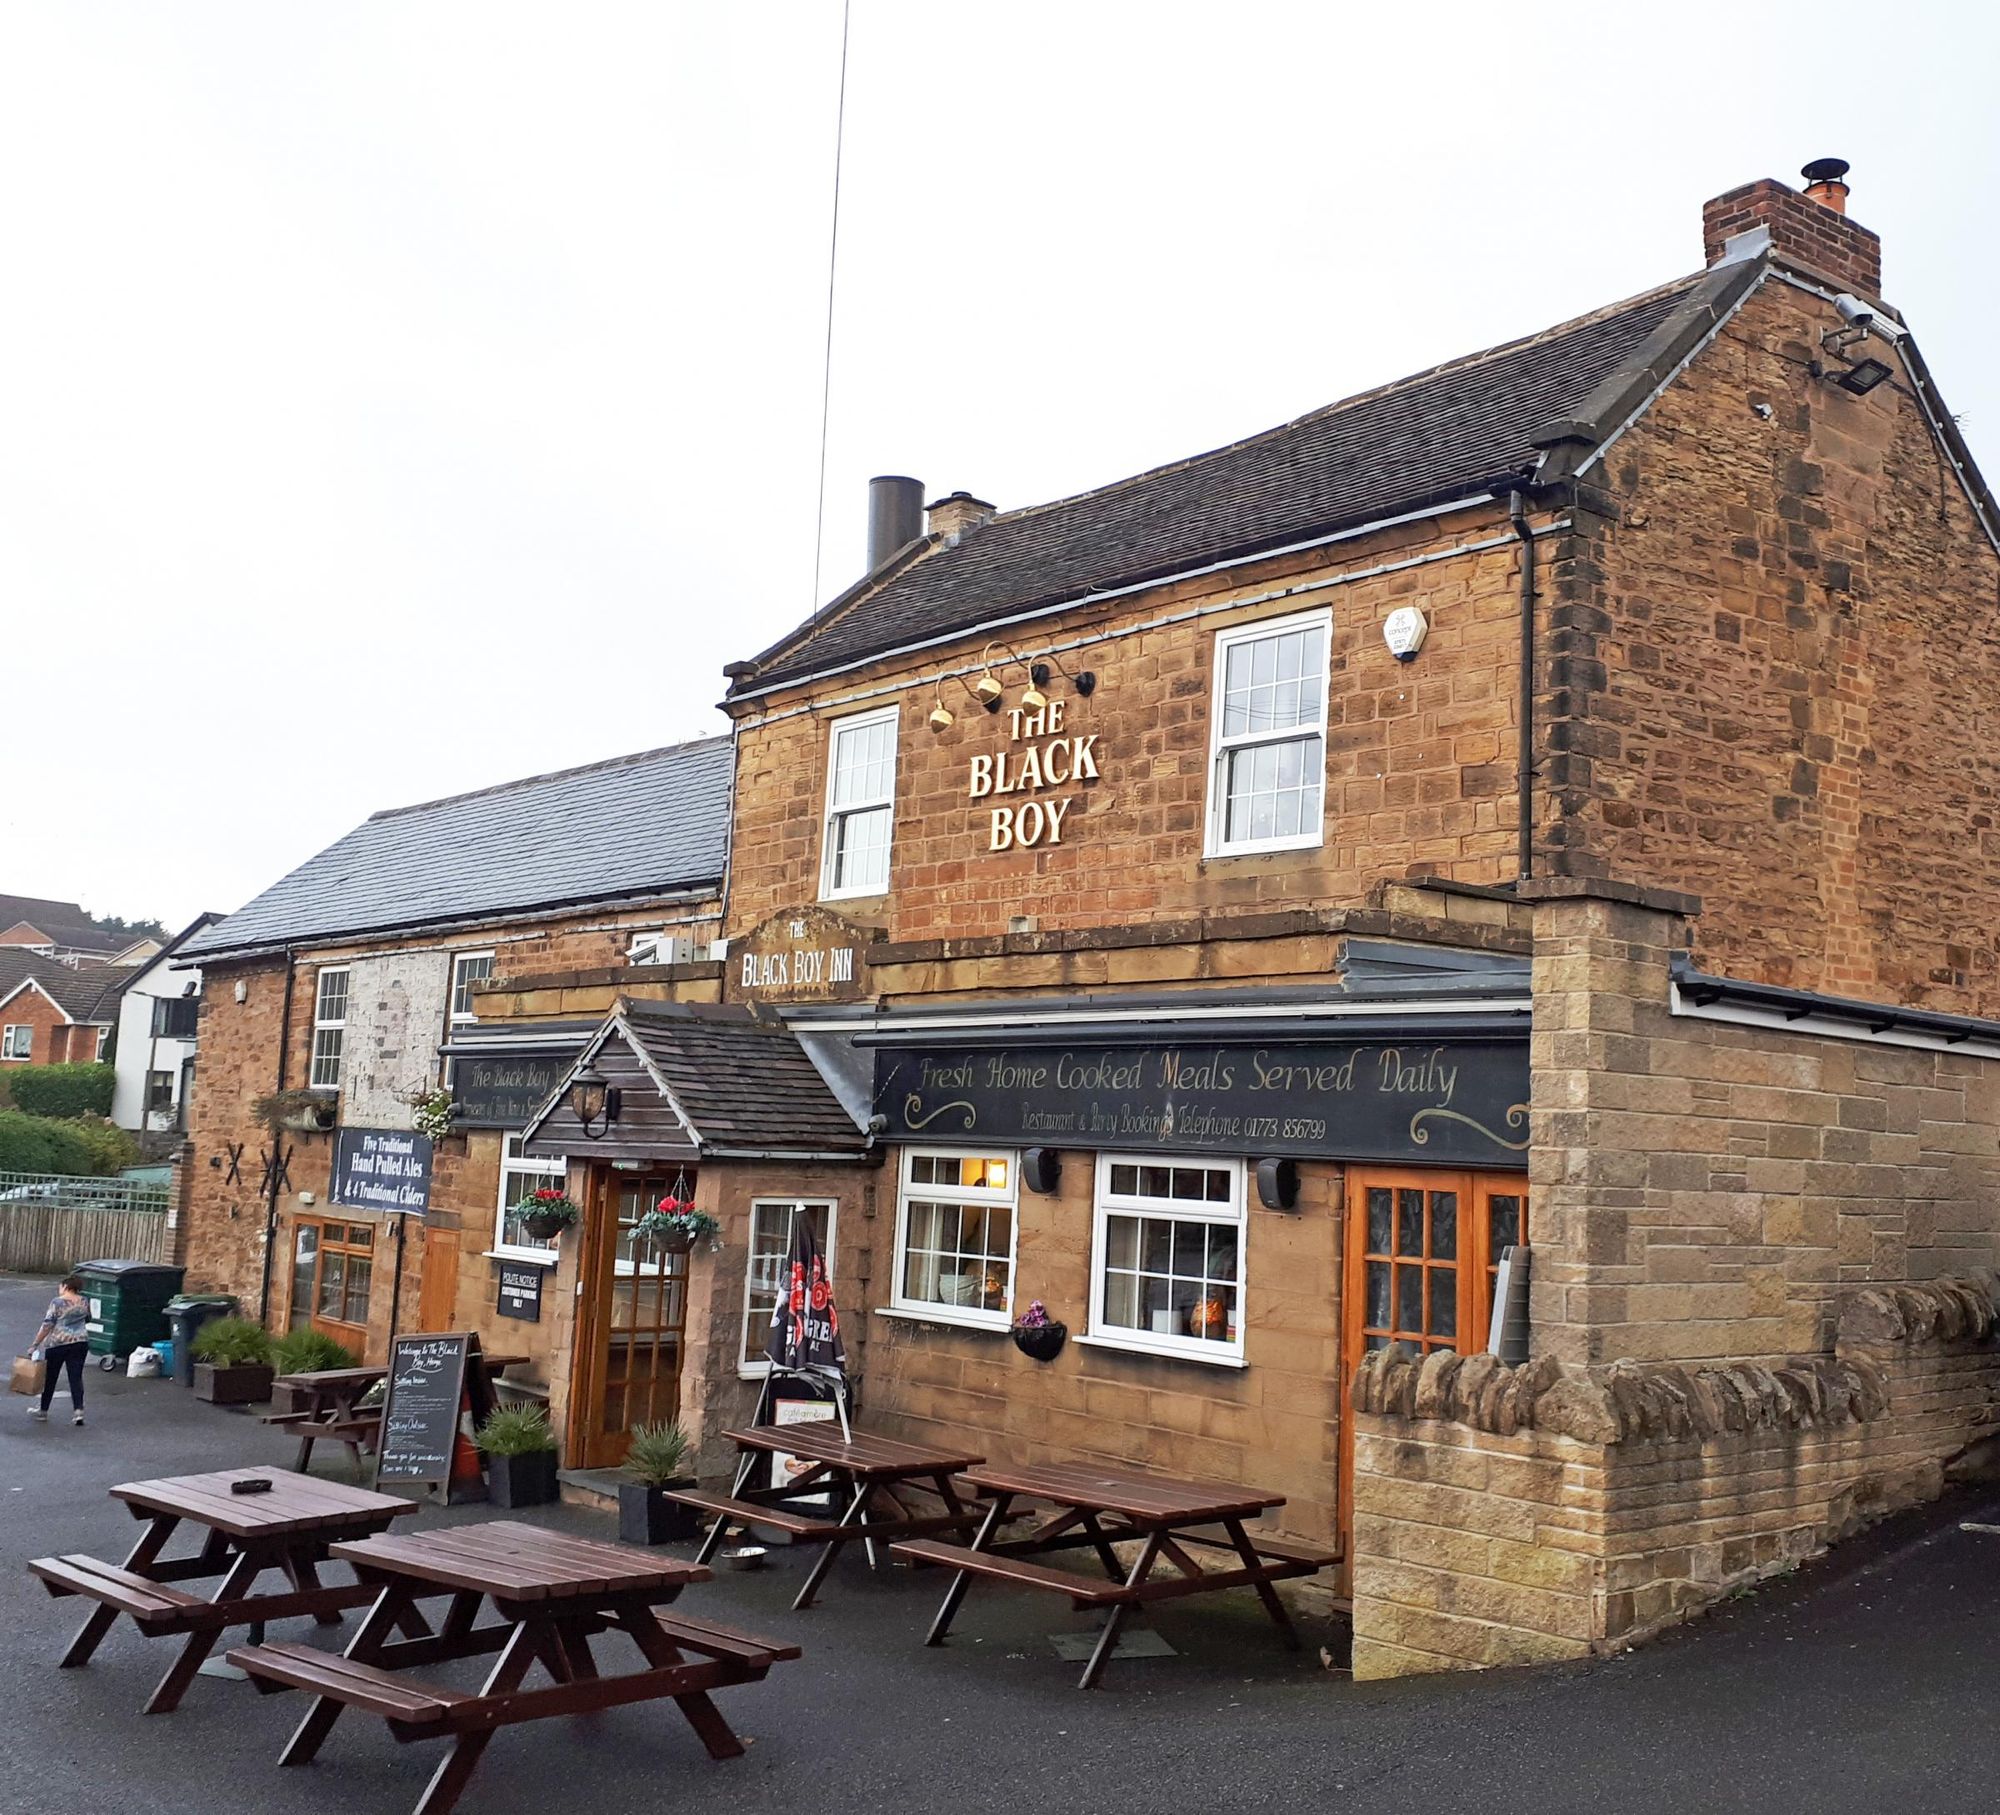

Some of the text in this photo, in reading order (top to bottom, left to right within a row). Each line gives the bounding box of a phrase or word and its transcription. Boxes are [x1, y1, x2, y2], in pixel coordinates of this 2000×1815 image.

[1007, 701, 1066, 740] THE
[969, 735, 1099, 797] BLACK
[989, 798, 1072, 850] BOY
[789, 921, 804, 938] THE
[741, 947, 853, 987] BLACK BOY INN
[471, 1063, 491, 1087] The
[494, 1063, 524, 1087] Black
[526, 1062, 551, 1095] Boy
[917, 1048, 1458, 1108] Fresh Home Cooked Meals Served Daily
[1021, 1102, 1326, 1141] Restaurant & Party Bookings Telephone 01773 856799
[363, 1136, 413, 1154] Five Traditional
[351, 1152, 423, 1178] Hand Pulled Ales
[344, 1179, 425, 1205] & 4 Traditional Ciders
[520, 1274, 538, 1287] NOTICE
